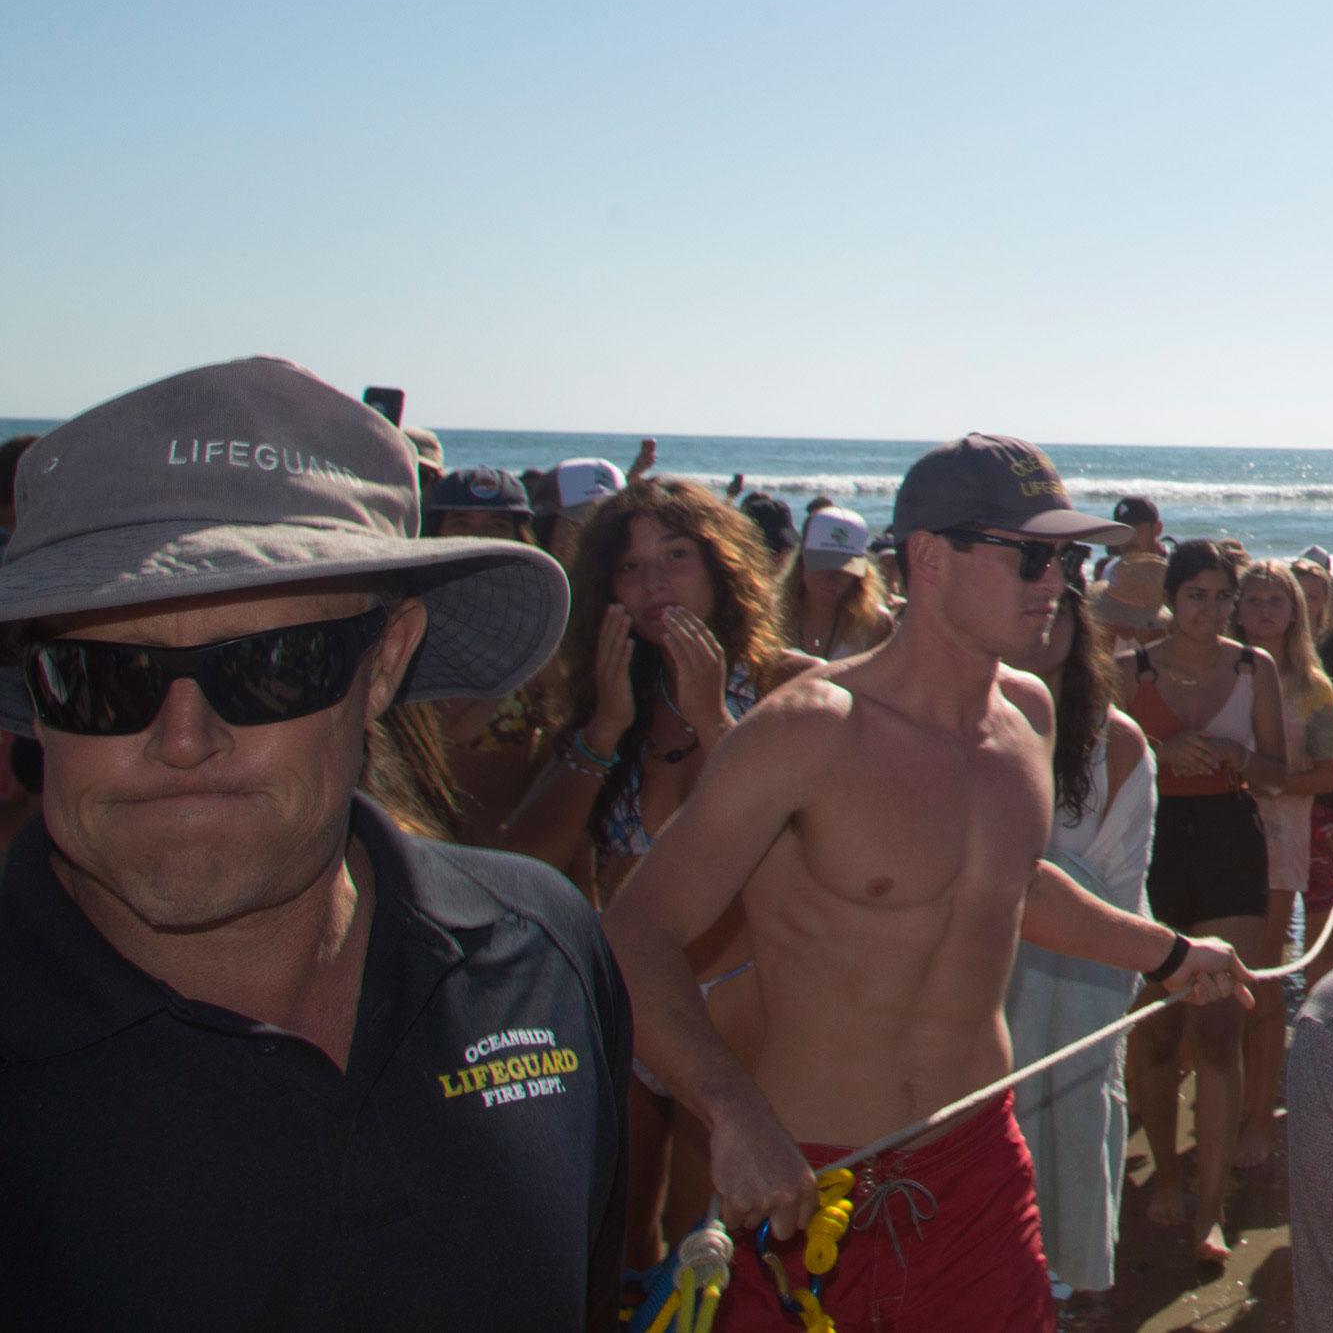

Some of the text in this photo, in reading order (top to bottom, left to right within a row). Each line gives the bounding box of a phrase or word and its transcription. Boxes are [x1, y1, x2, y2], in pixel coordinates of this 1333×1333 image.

[464, 1027, 556, 1064] OCEANSIDE
[438, 1047, 579, 1098] LIFEGUARD
[481, 1081, 526, 1108] FIRE
